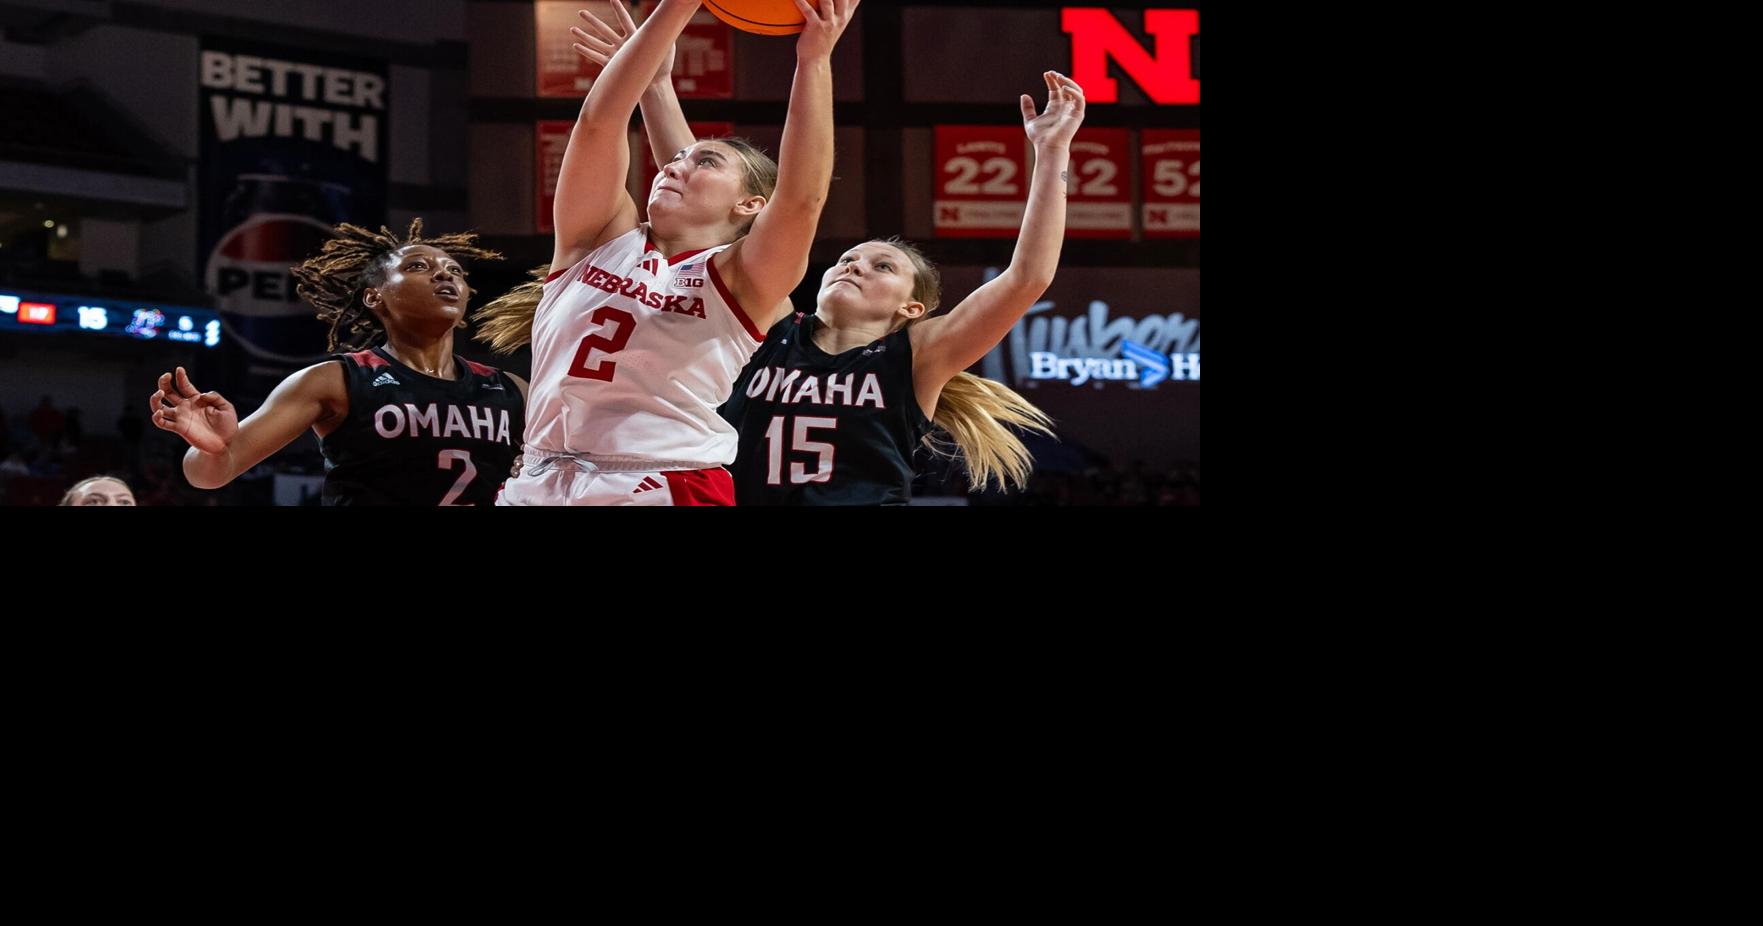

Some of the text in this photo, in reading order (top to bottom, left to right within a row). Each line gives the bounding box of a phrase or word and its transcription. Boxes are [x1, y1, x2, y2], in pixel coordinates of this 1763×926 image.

[201, 50, 385, 110] BETTER
[1061, 7, 1200, 105] N
[210, 94, 378, 162] WITH
[944, 157, 1018, 195] 22
[577, 263, 707, 320] NEBRASKA
[567, 305, 637, 383] 2
[1029, 351, 1138, 386] Bryan
[745, 365, 887, 410] OMAHA
[373, 402, 511, 446] OMAHA
[764, 415, 838, 486] 15
[437, 449, 478, 506] 2
